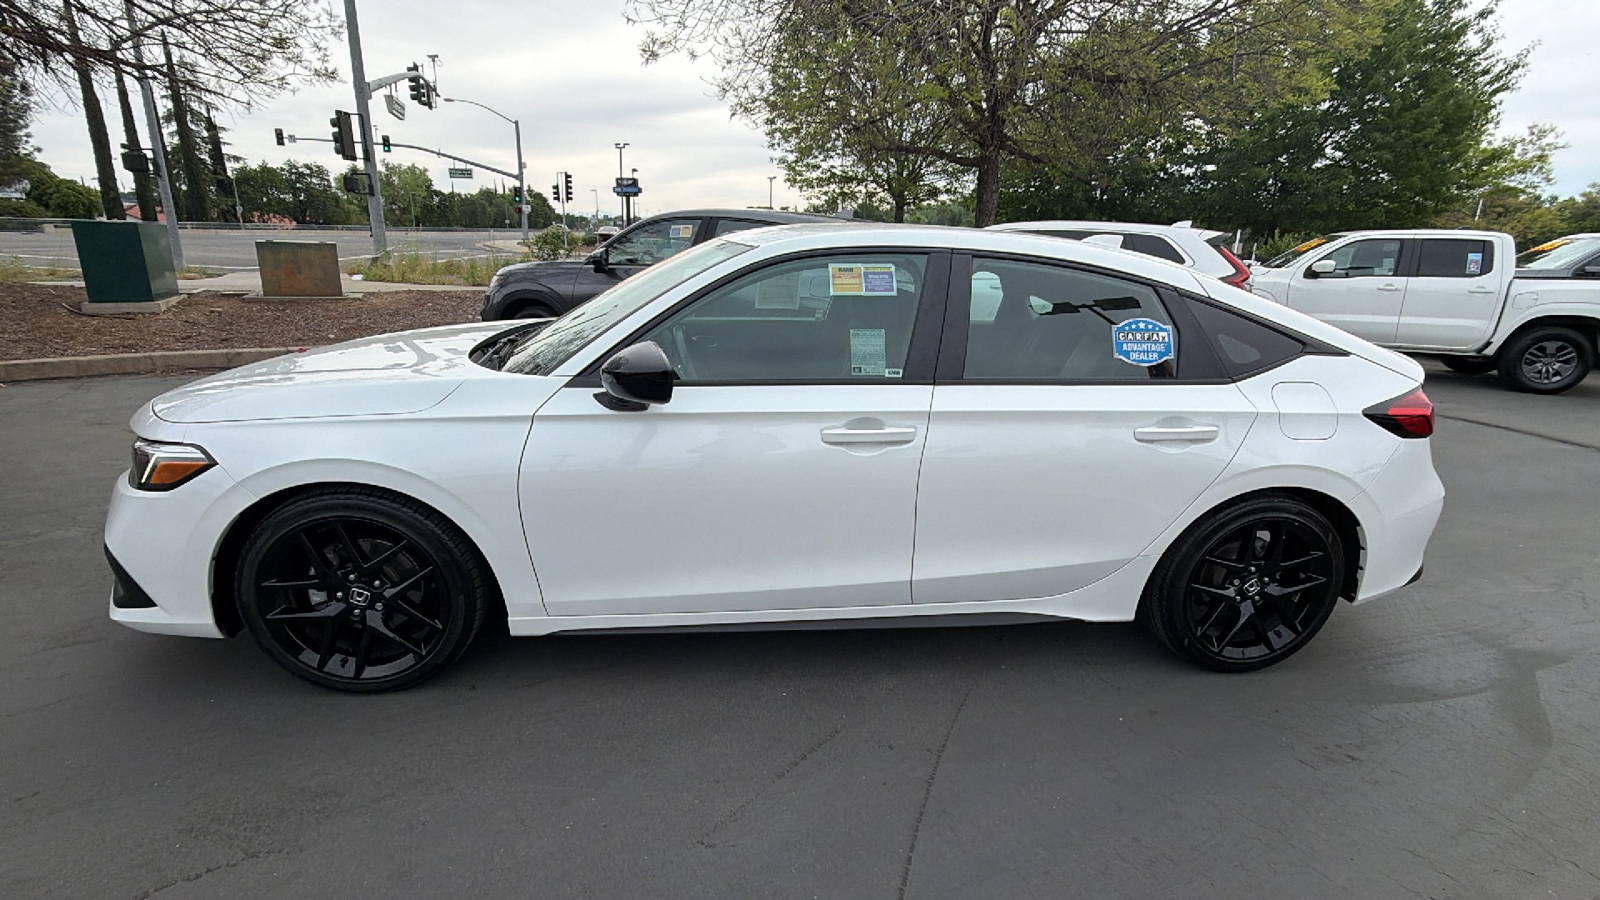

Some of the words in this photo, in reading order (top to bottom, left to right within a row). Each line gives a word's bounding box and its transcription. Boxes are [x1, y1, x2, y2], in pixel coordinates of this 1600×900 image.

[1118, 331, 1168, 341] CARFAX
[1122, 343, 1165, 352] ADVANTAGE
[1130, 352, 1158, 360] DEALER
